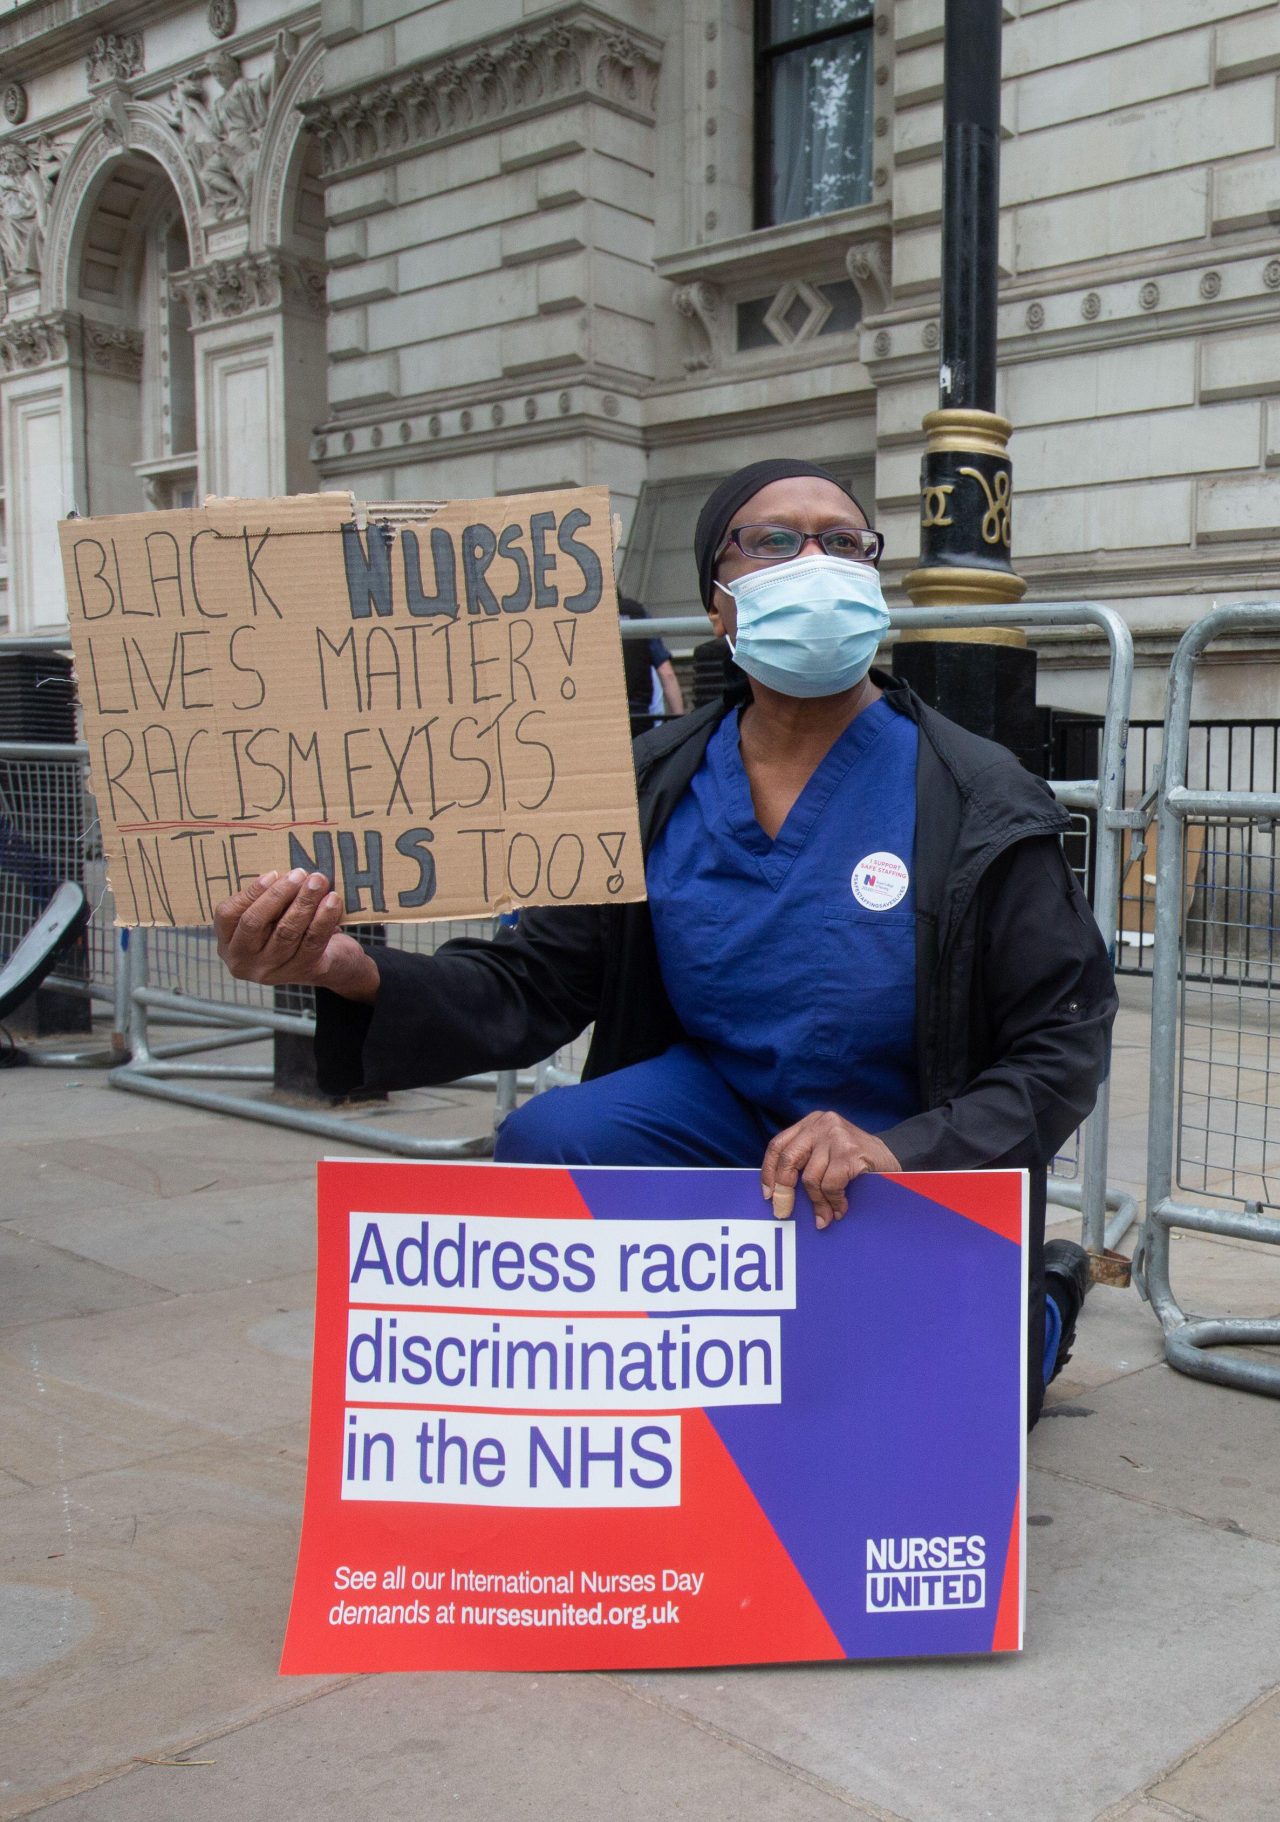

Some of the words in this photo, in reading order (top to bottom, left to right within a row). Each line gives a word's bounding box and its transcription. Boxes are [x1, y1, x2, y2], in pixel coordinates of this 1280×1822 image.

[72, 525, 283, 619] BLACK
[341, 507, 604, 619] NURSES
[87, 625, 266, 714] LIVES
[316, 614, 577, 712] MATTER!
[102, 725, 330, 823] RACISM
[344, 700, 555, 820] EXISTS
[122, 836, 176, 926] IN
[350, 1222, 596, 1293] Address
[618, 1227, 785, 1293] racial
[348, 1317, 773, 1391] discrimination
[346, 1415, 395, 1482] in
[416, 1419, 506, 1487] the
[529, 1426, 673, 1489] NHS
[334, 1566, 377, 1590] See
[382, 1565, 406, 1590] all
[412, 1571, 446, 1590] our
[451, 1568, 574, 1594] International
[581, 1571, 656, 1593] Nurses
[662, 1569, 705, 1596] Day
[866, 1535, 986, 1570] NURSES
[328, 1599, 430, 1626] demands
[435, 1602, 456, 1624] at
[461, 1600, 680, 1630] nursesunited.org.uk
[869, 1573, 982, 1608] UNITED
